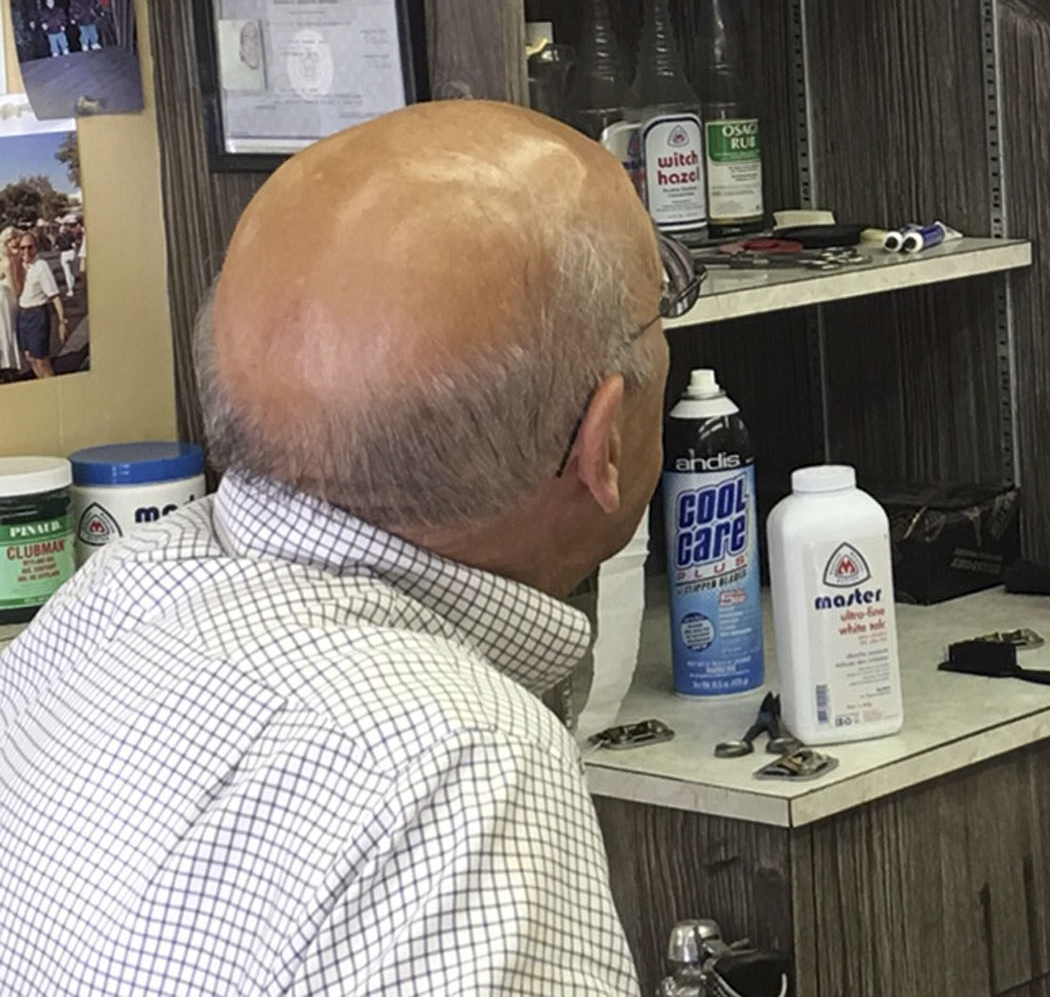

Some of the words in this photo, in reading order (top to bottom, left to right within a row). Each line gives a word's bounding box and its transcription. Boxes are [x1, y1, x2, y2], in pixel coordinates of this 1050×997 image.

[657, 150, 699, 169] witch
[657, 167, 700, 185] hazel
[675, 452, 741, 471] andis
[814, 588, 882, 610] master
